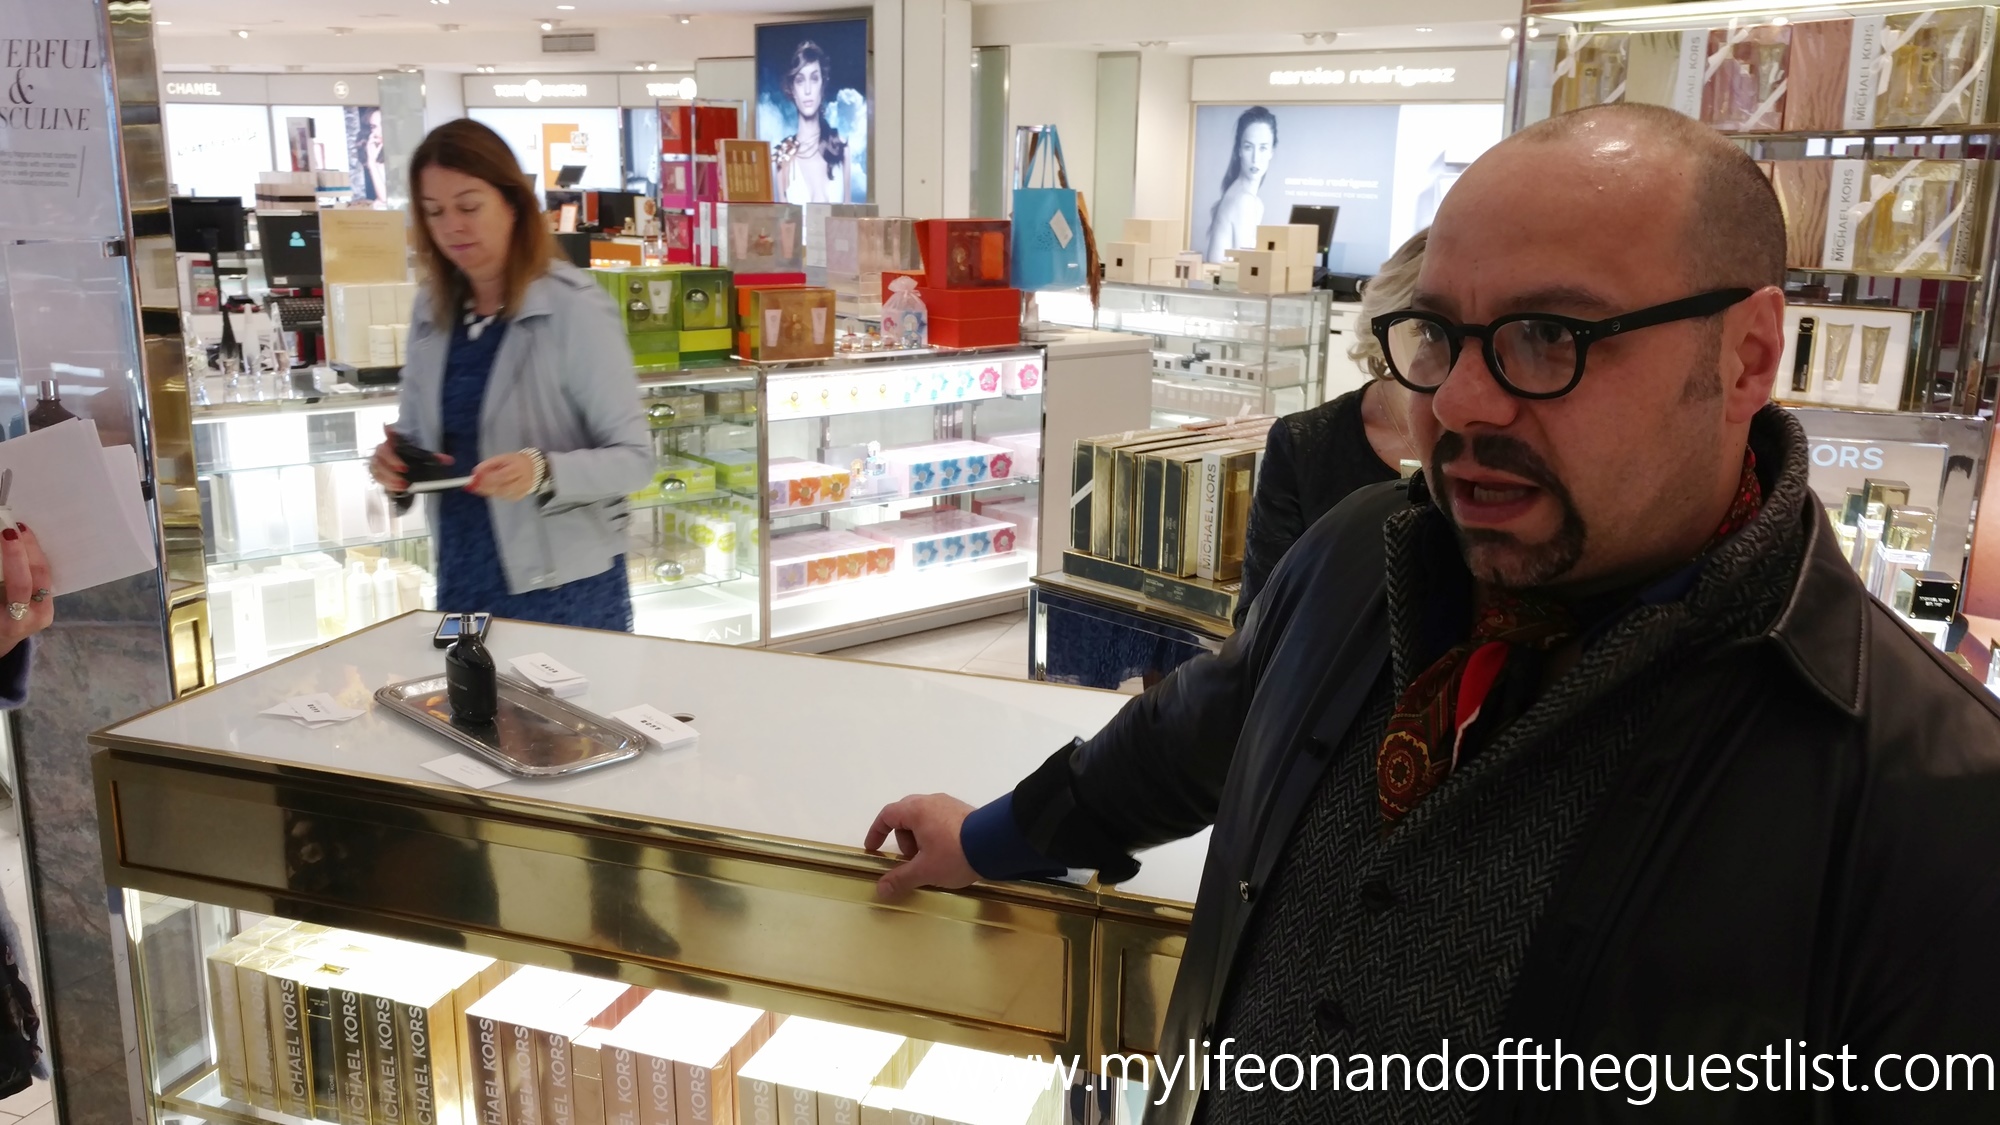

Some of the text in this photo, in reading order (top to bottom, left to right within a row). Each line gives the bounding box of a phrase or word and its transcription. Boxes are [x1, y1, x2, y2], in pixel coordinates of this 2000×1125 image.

[1689, 36, 1700, 70] KORS
[1862, 24, 1875, 60] KORS
[9, 68, 34, 105] &
[166, 82, 221, 96] CHANEL
[1270, 65, 1456, 87] narciso rodriguez
[1855, 63, 1870, 121] MICHAEL
[1834, 168, 1854, 262] MICHAEL KORS
[1808, 444, 1884, 470] ORS
[1202, 464, 1217, 570] MICHAEL KORS
[280, 979, 298, 1032] KORS
[341, 990, 359, 1044] KORS
[376, 997, 393, 1050] KORS
[408, 1005, 426, 1059] KORS
[479, 1017, 496, 1071] KORS
[513, 1025, 531, 1079] KORS
[549, 1034, 567, 1088] KORS
[615, 1048, 632, 1104] KORS
[651, 1056, 669, 1113] KORS
[689, 1065, 707, 1122] KORS
